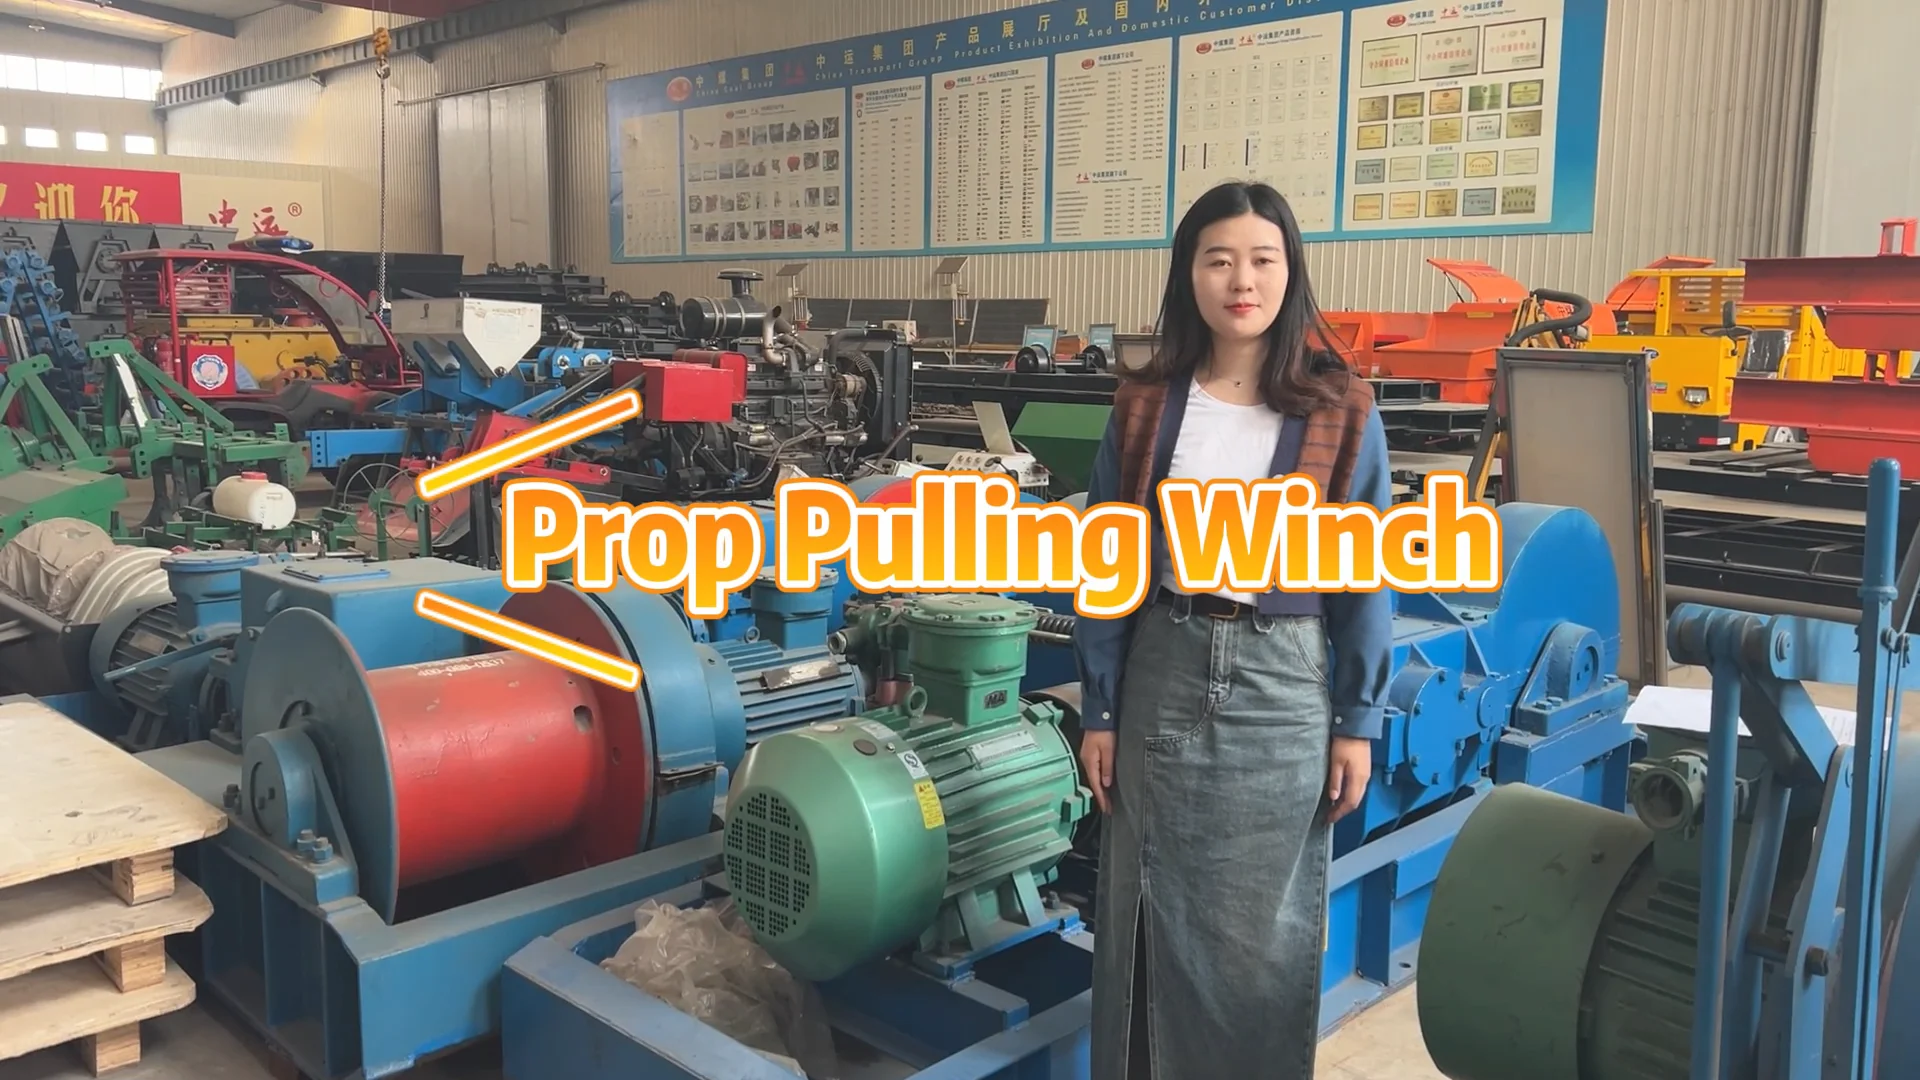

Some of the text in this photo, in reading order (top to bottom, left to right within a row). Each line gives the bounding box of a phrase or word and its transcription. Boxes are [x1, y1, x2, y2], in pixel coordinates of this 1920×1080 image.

[850, 62, 902, 76] Transport
[909, 55, 943, 68] Group
[955, 44, 1001, 58] Product
[1009, 33, 1079, 50] Exhibition
[1088, 26, 1113, 38] And
[1121, 15, 1189, 33] Domestic
[1200, 1, 1275, 21] Customer
